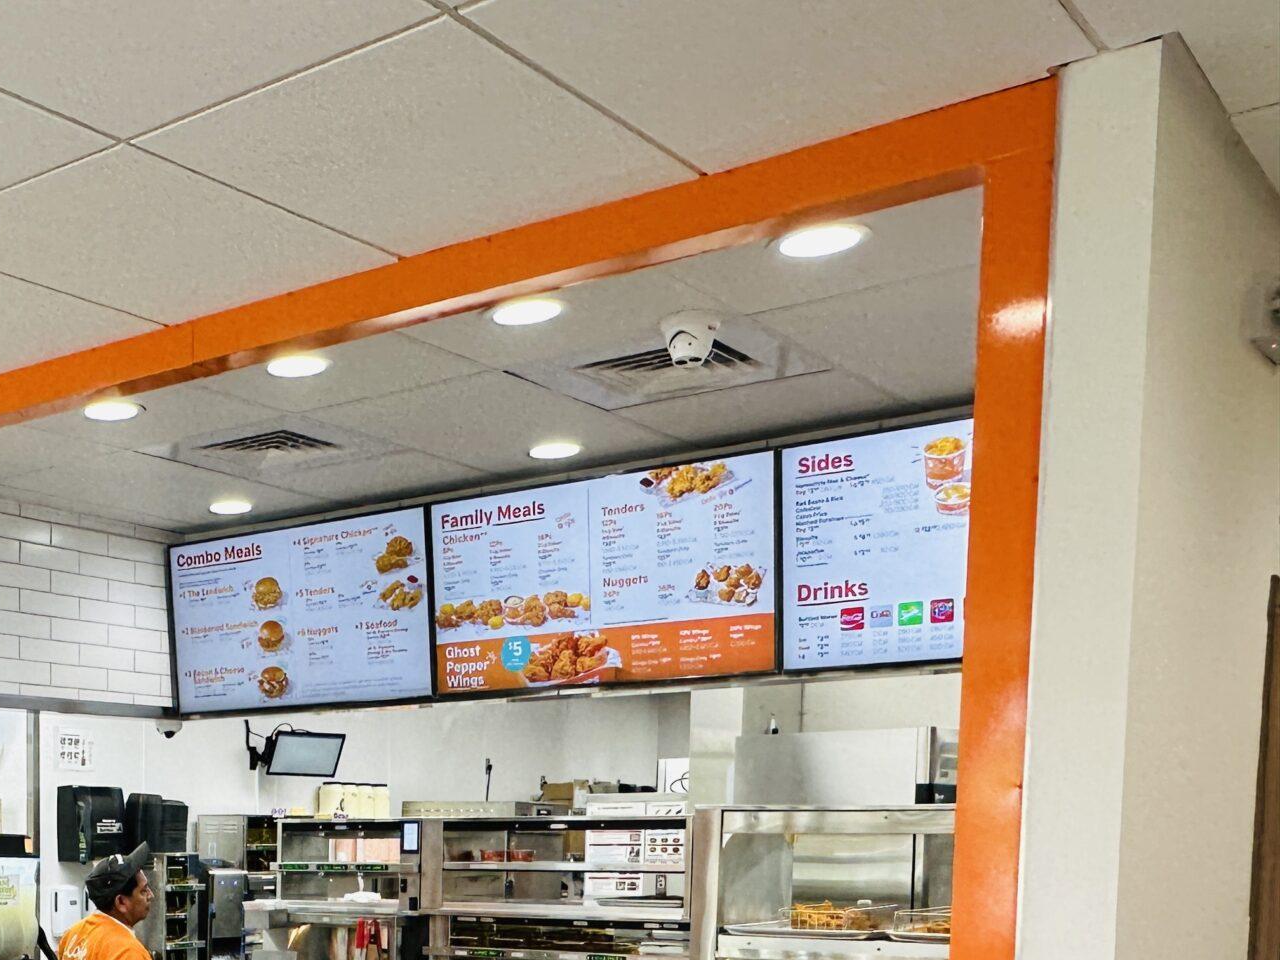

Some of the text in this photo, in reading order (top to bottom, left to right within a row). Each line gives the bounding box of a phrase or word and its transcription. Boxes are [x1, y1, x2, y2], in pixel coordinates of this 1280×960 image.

[798, 453, 853, 474] Sides
[441, 501, 545, 530] Family Meals
[601, 504, 645, 517] Tenders
[442, 532, 480, 546] Chicken
[177, 542, 262, 568] Combo Meals
[602, 575, 648, 588] Nuggets
[305, 585, 335, 597] Tenders
[797, 579, 869, 602] Drinks
[446, 645, 481, 659] Ghost
[508, 641, 522, 656] $5
[446, 659, 489, 676] Pepper
[446, 674, 485, 689] Wings
